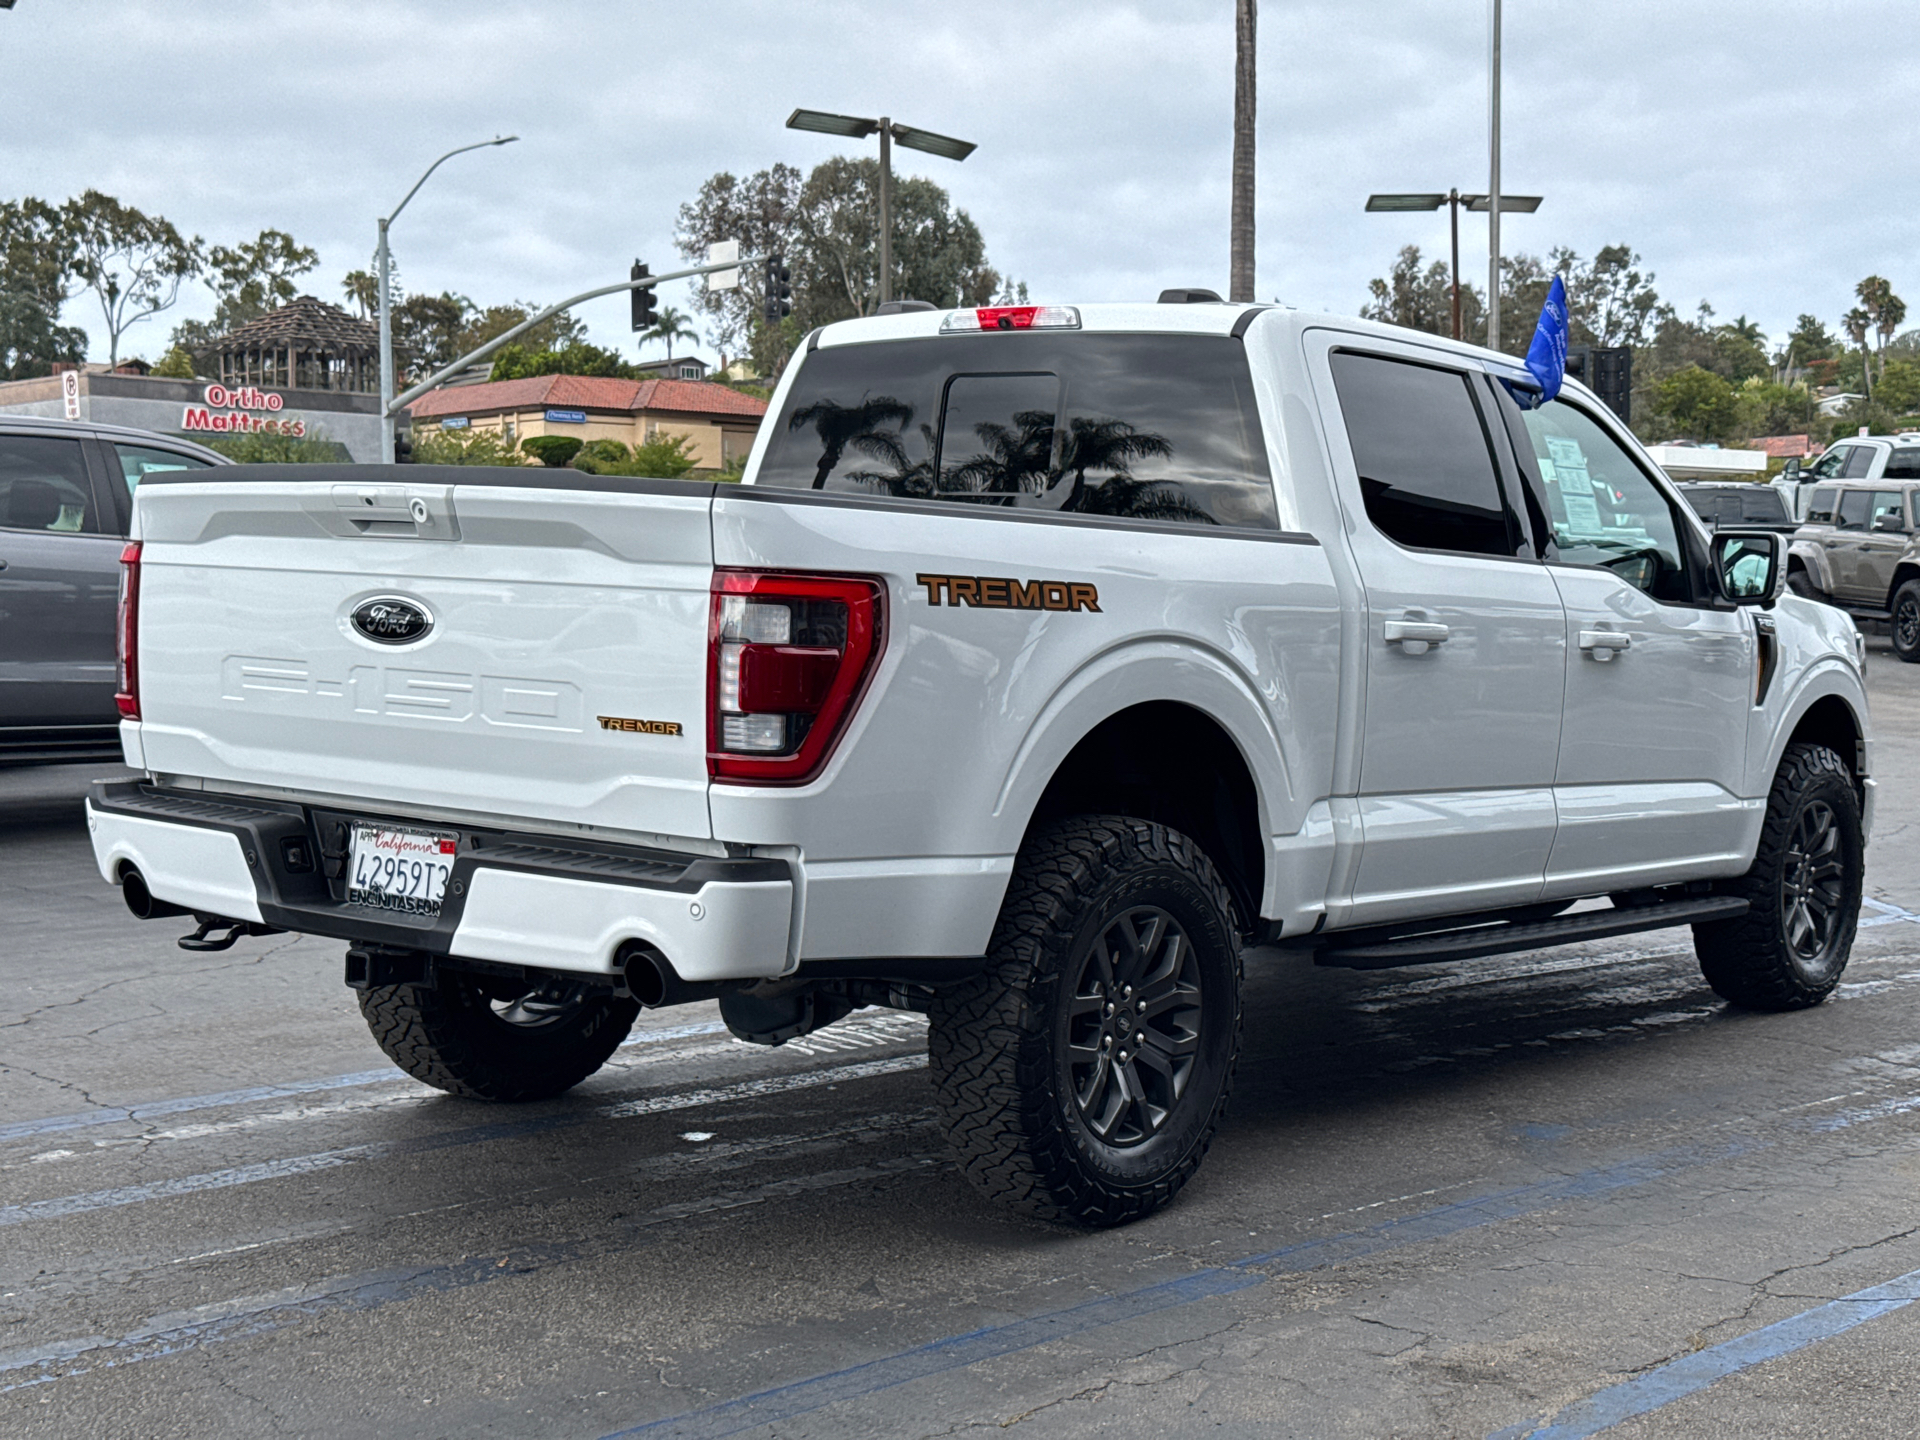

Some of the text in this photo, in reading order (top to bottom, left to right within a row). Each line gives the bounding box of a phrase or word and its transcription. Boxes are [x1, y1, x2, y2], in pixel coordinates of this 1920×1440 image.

[205, 385, 283, 411] Ortho
[182, 406, 305, 437] Mattress
[916, 573, 1104, 613] TREMOR
[366, 604, 411, 634] Ford
[221, 655, 582, 733] F-150
[597, 716, 684, 737] TREMOR
[375, 830, 439, 856] California
[356, 853, 449, 899] 42959T3
[350, 889, 441, 917] ENCINITAS FOR
